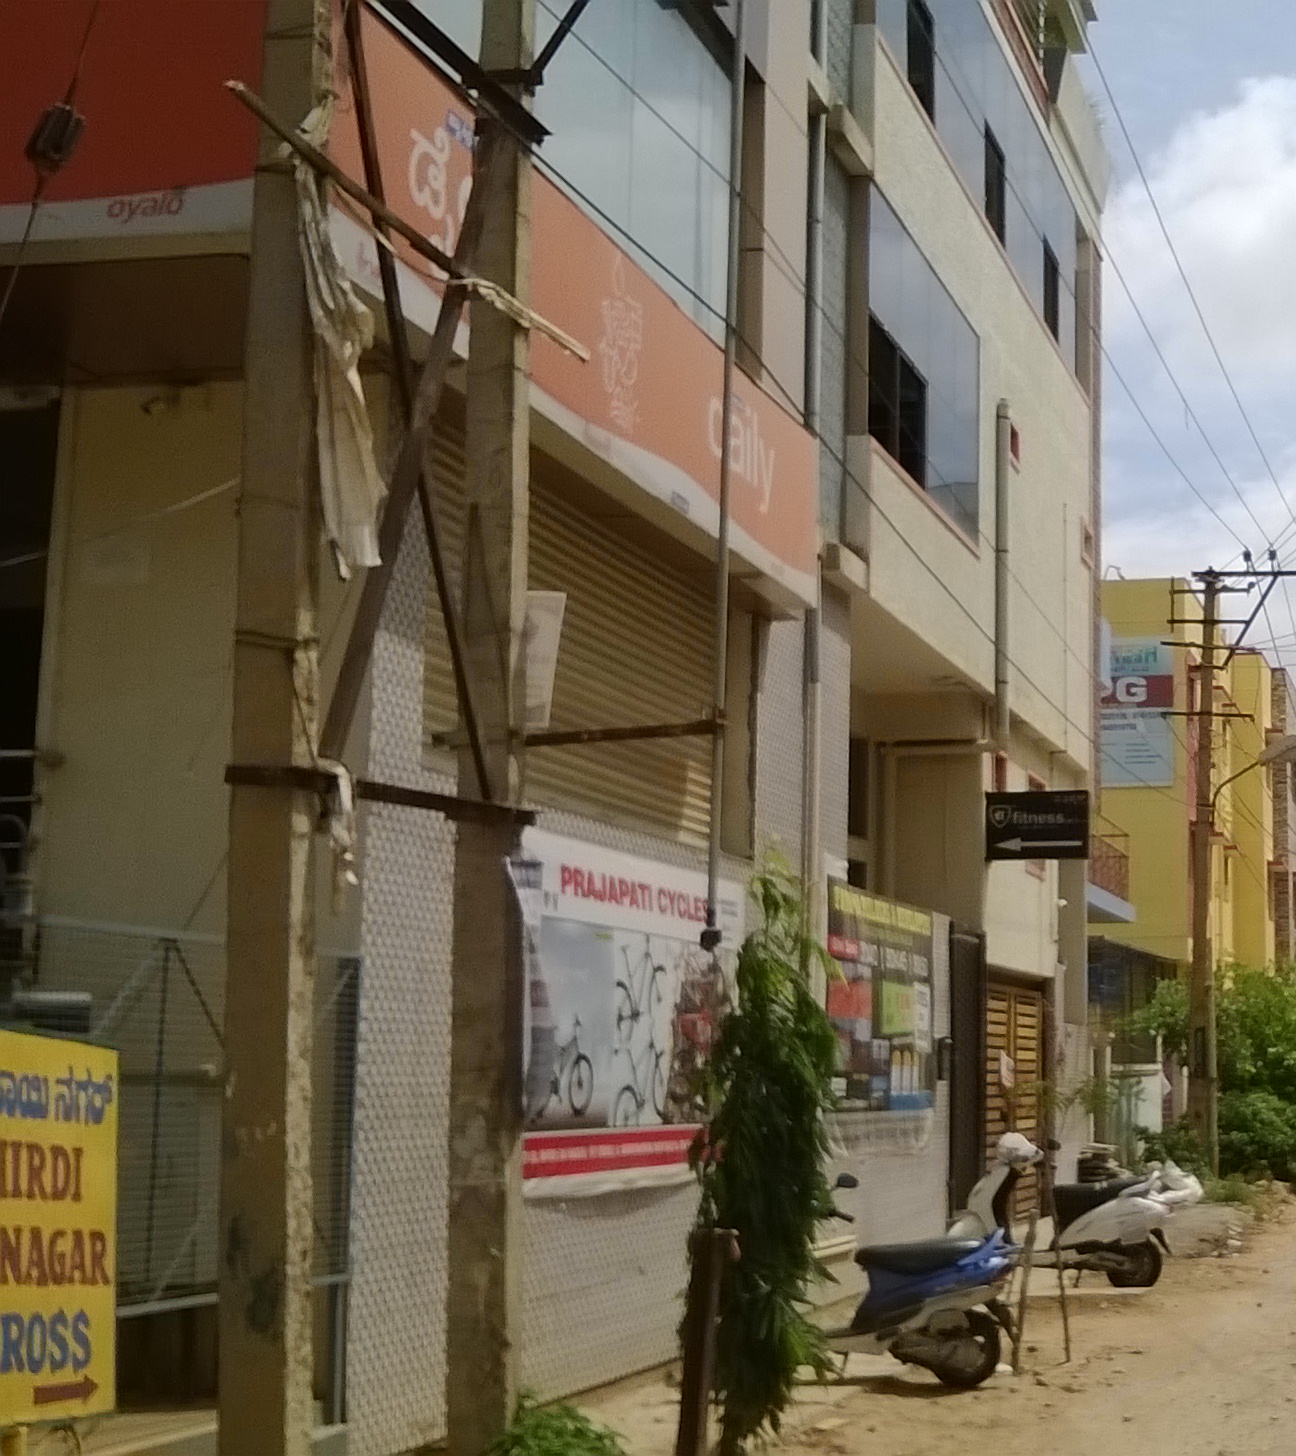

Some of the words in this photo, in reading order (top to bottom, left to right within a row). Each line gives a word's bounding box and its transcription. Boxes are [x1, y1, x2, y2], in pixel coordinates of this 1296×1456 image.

[1012, 810, 1064, 825] fitness
[561, 864, 653, 912] PRAJAPATI
[657, 886, 709, 922] CYCLES
[0, 1225, 110, 1287] NAGAR
